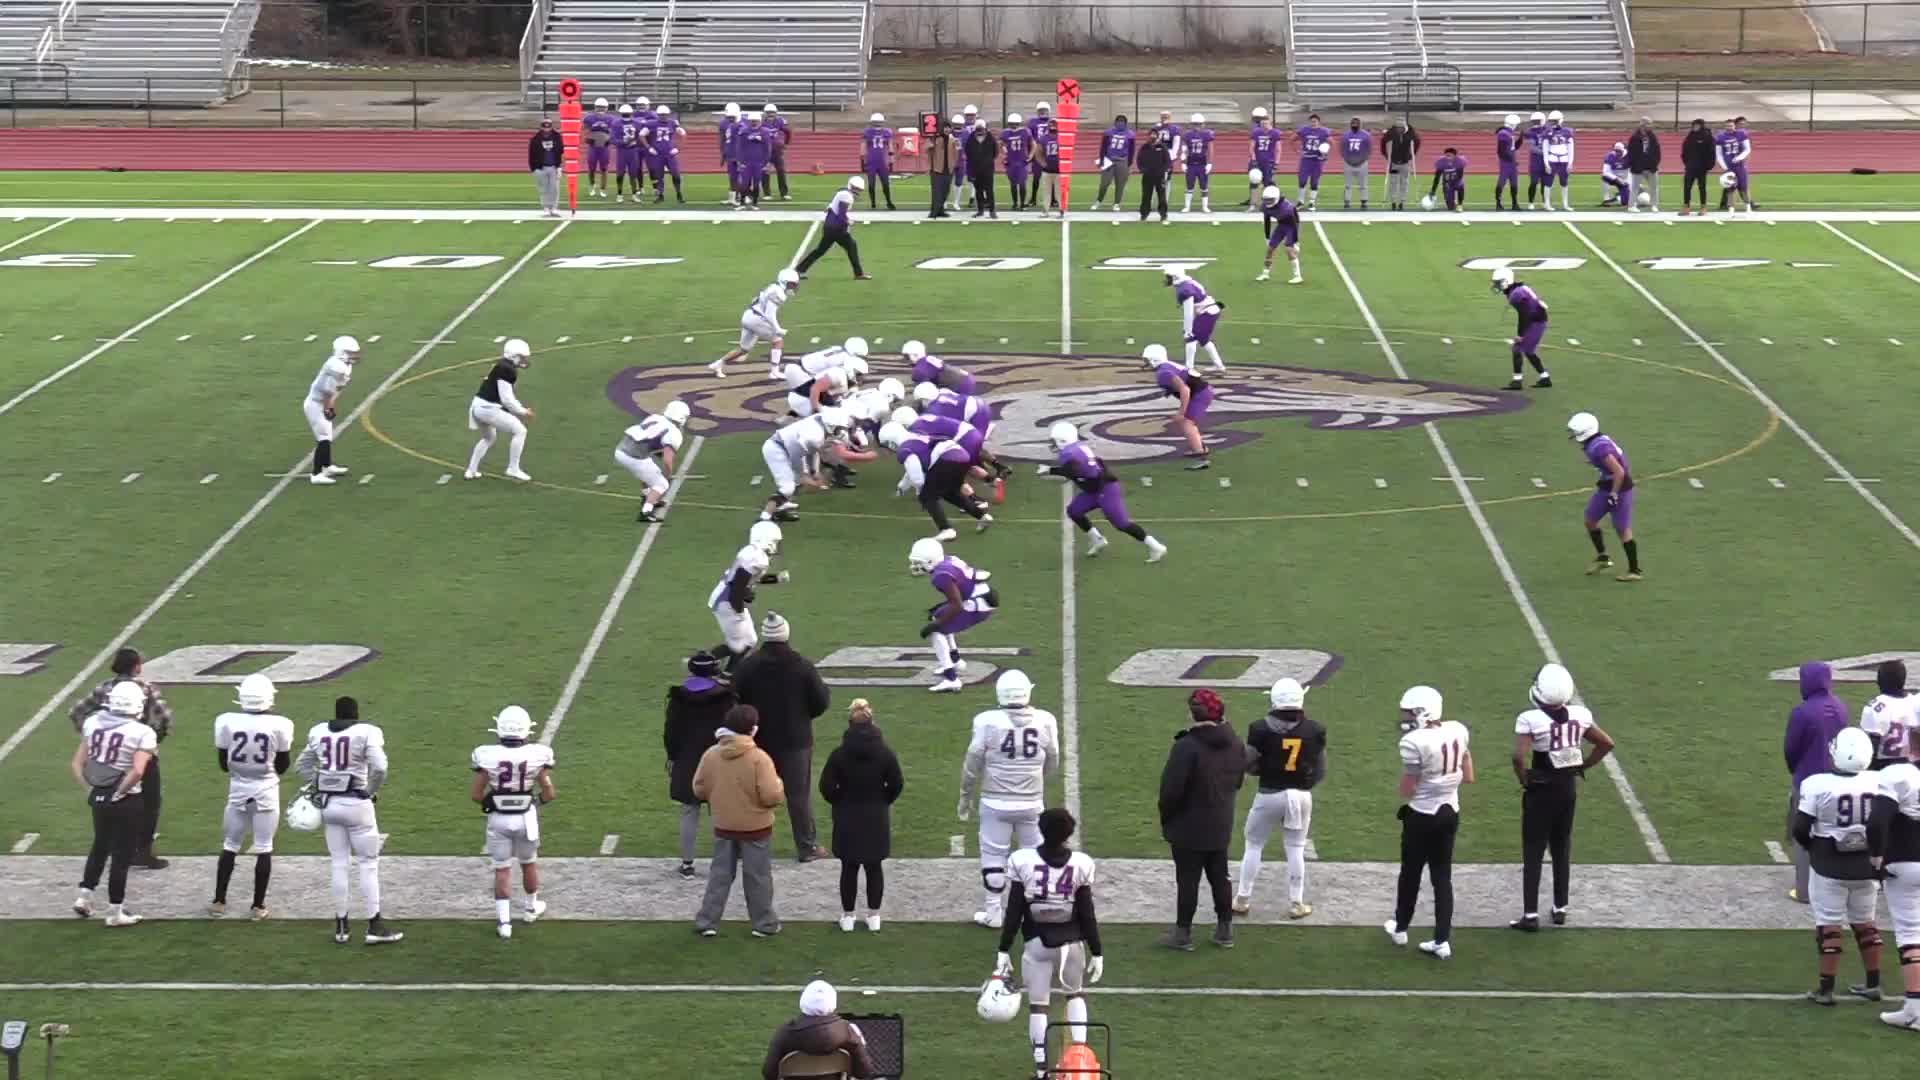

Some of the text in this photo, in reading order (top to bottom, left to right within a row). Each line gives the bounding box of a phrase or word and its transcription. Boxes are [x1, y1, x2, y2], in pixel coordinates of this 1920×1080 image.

[924, 115, 937, 133] 2
[88, 729, 125, 765] 88
[231, 731, 270, 764] 23
[1000, 727, 1039, 759] 46
[1550, 719, 1581, 751] 80
[1883, 720, 1911, 757] 2
[320, 736, 350, 771] 30
[1282, 738, 1302, 771] 7
[1441, 738, 1460, 776] 11
[498, 760, 528, 794] 21
[1837, 792, 1874, 827] 90
[1033, 864, 1074, 900] 34
